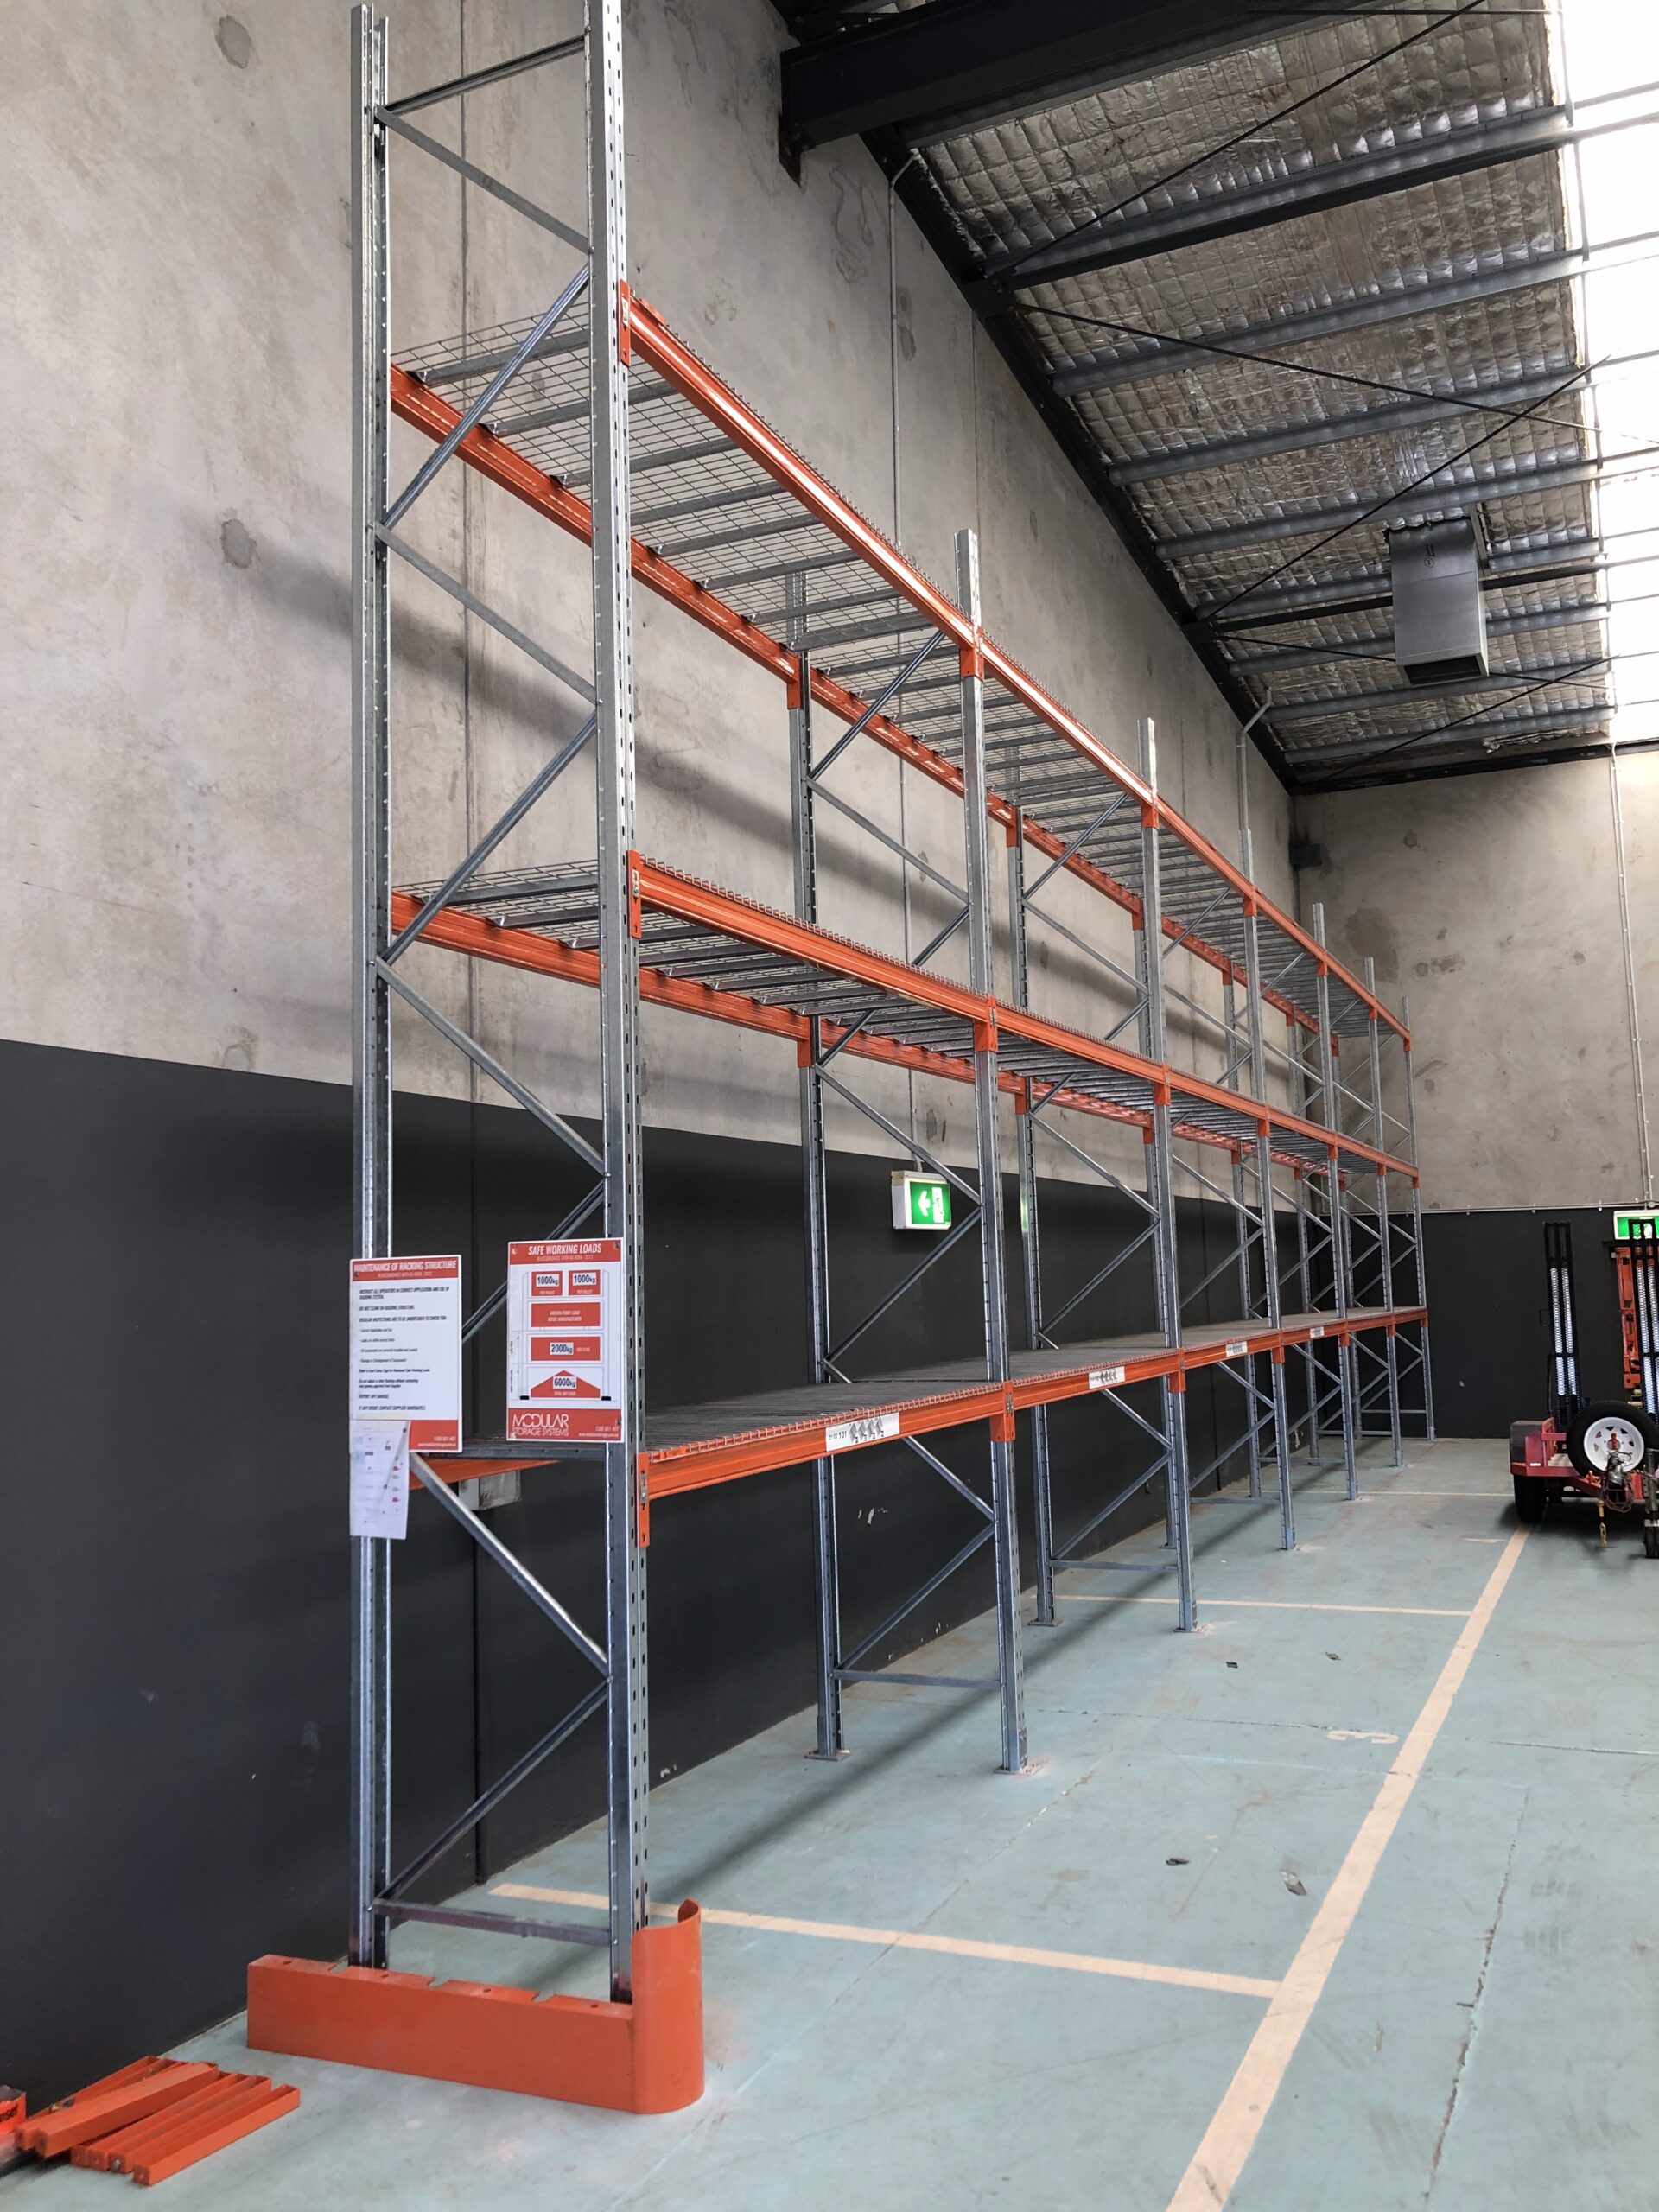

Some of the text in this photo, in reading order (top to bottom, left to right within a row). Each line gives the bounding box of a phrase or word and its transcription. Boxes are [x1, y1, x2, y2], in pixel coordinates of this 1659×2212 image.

[528, 1243, 602, 1255] SAFE WORKING LOADS
[353, 1260, 457, 1272] MAINTENANCE OF RACKING STRUCTURE
[512, 1414, 569, 1427] MODULAR
[542, 1427, 569, 1436] SYSTEMS
